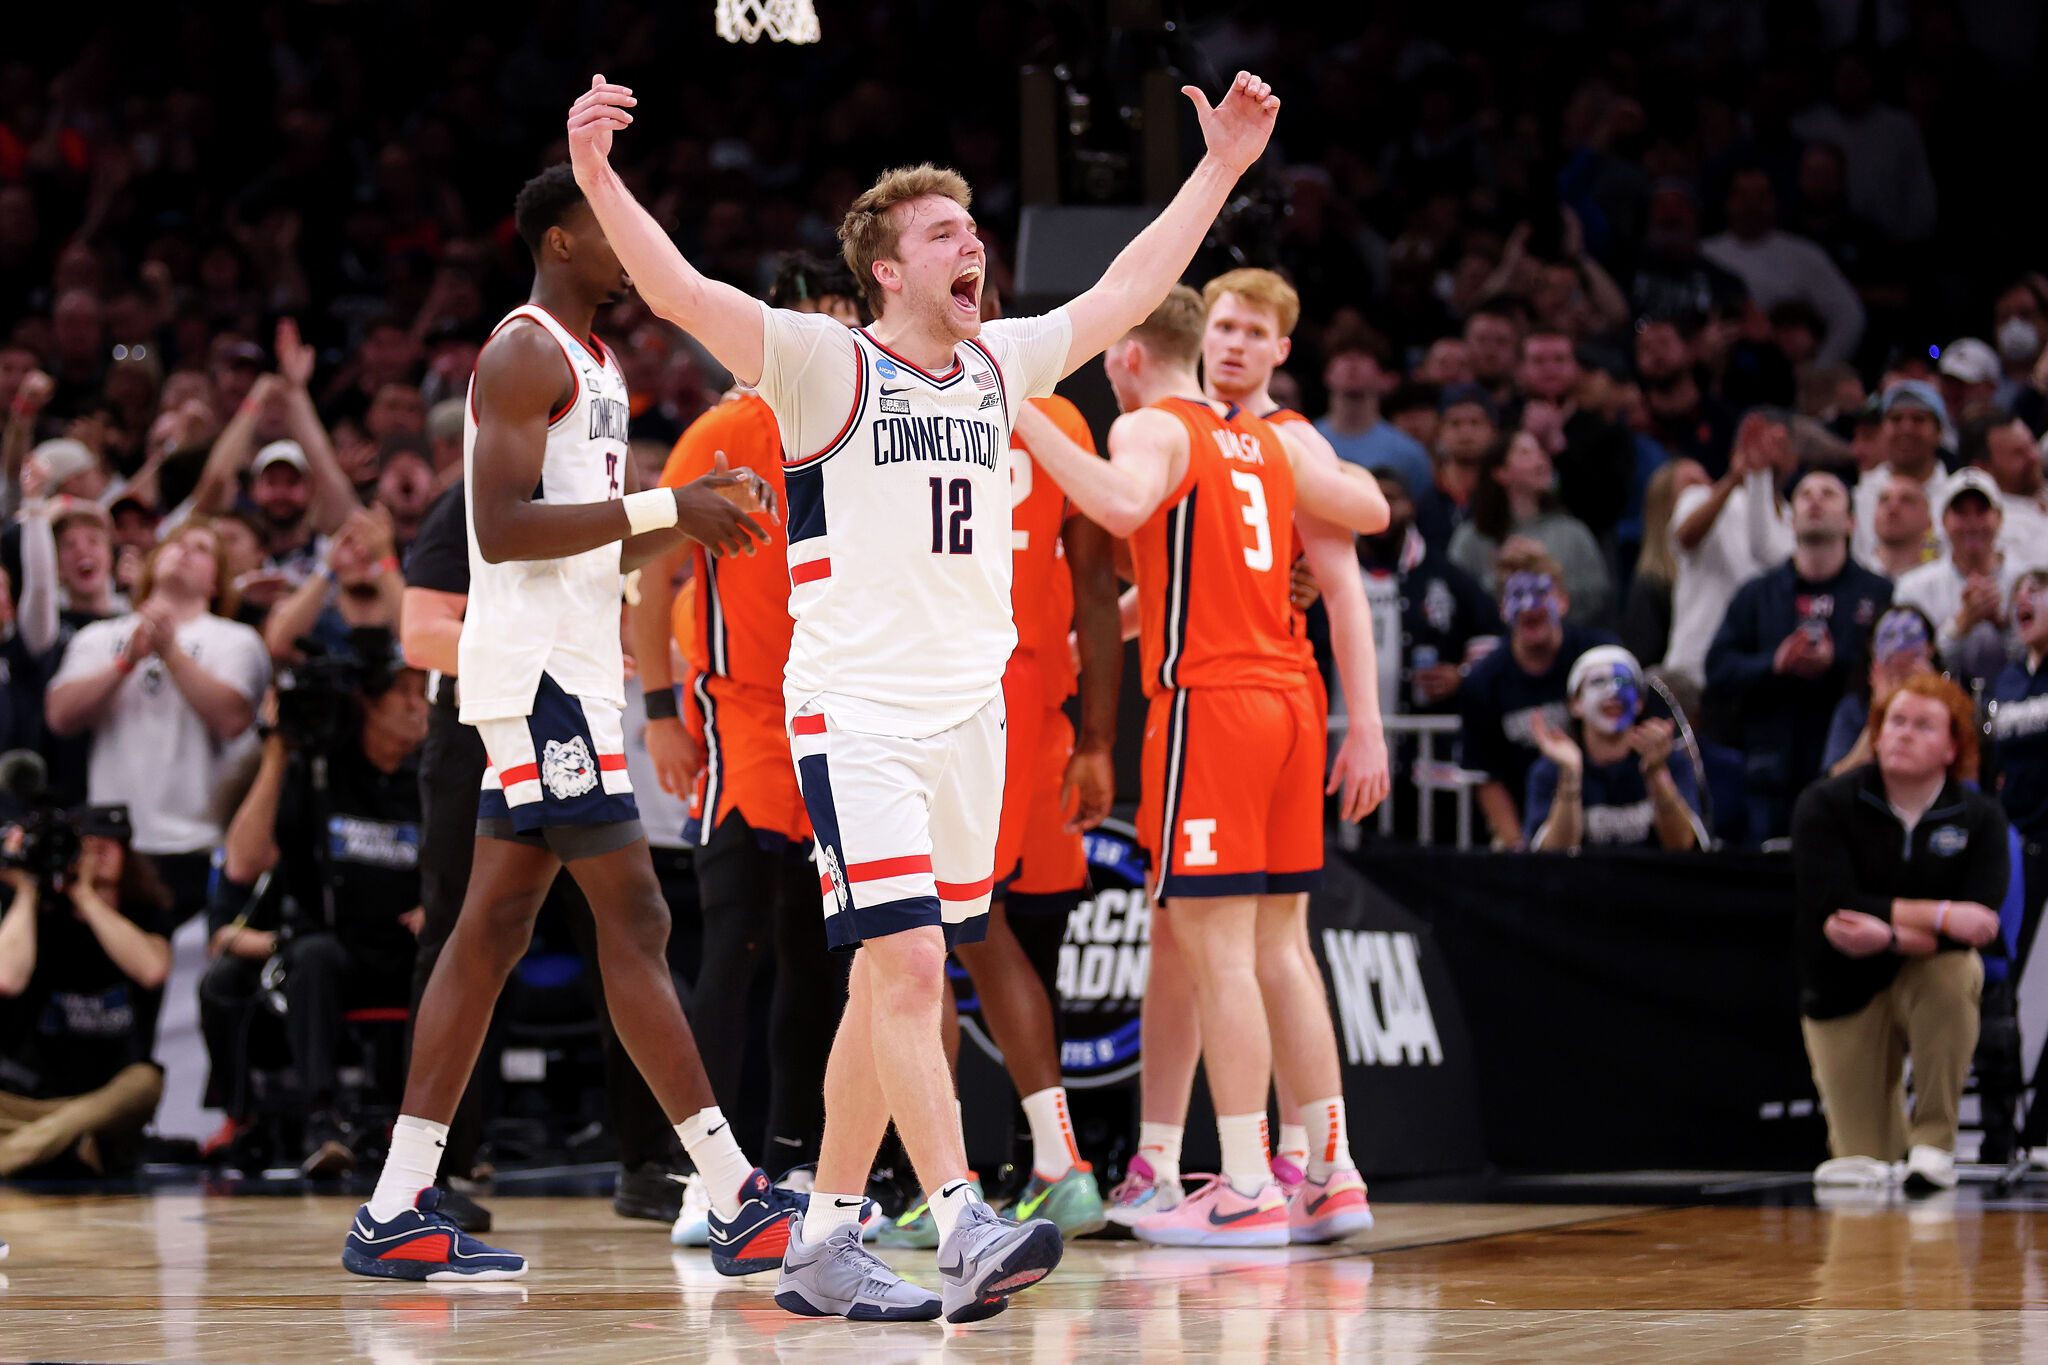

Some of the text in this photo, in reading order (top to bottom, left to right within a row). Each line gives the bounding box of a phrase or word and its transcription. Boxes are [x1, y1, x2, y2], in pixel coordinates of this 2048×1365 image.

[879, 366, 896, 376] NCAA
[929, 476, 973, 555] 12
[1231, 468, 1273, 572] 3
[1184, 818, 1218, 866] I
[1064, 888, 1152, 944] RCH
[1322, 928, 1444, 1067] NCAA
